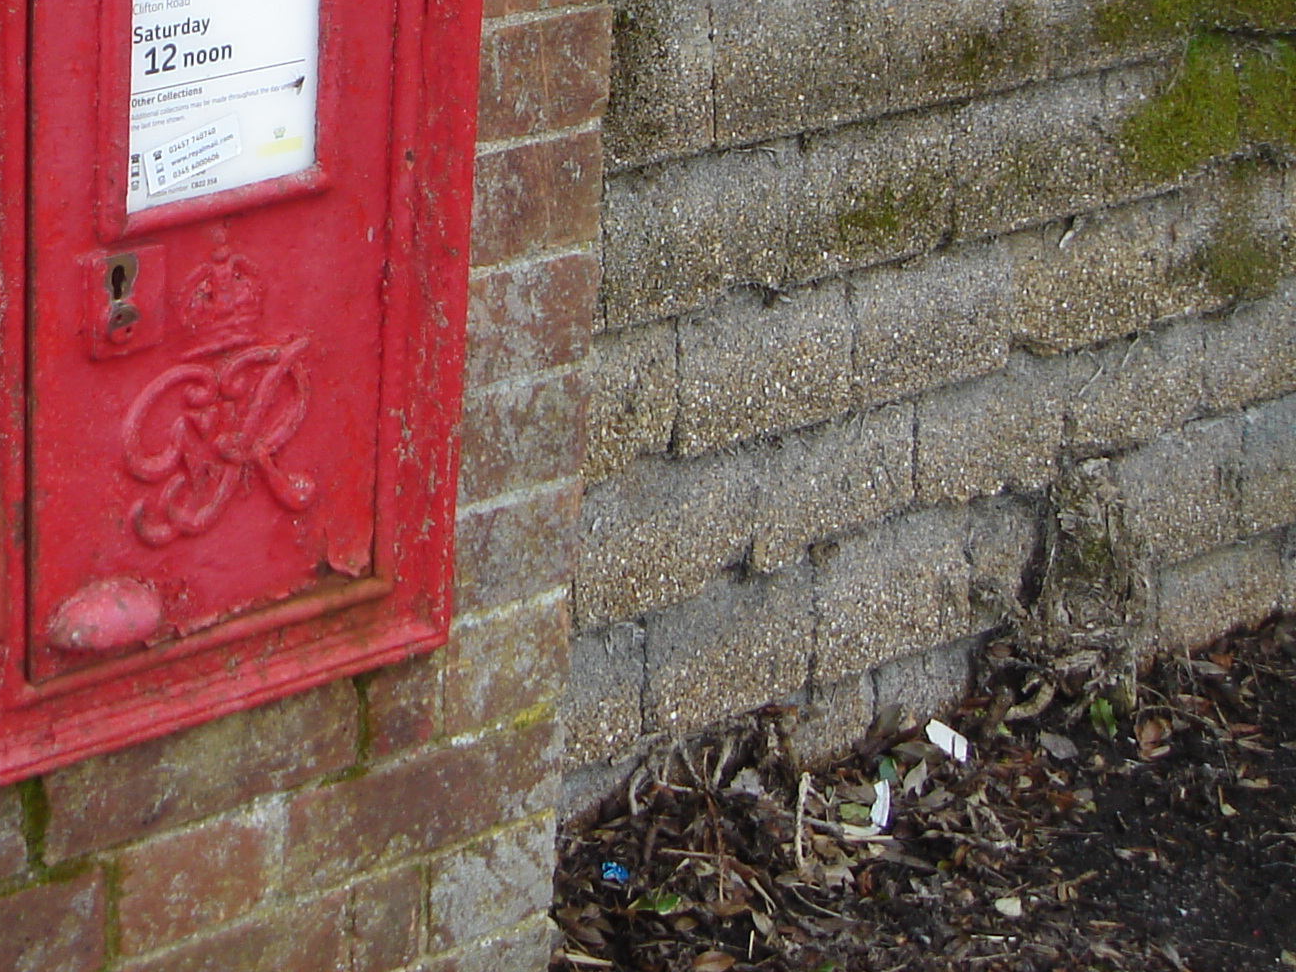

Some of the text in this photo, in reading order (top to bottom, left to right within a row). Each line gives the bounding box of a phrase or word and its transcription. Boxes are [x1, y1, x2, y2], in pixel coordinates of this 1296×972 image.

[132, 1, 164, 16] Clifton
[133, 17, 210, 44] Saturday
[144, 43, 233, 76] 12 noon
[131, 86, 203, 108] Other Collections
[168, 138, 190, 154] 03457
